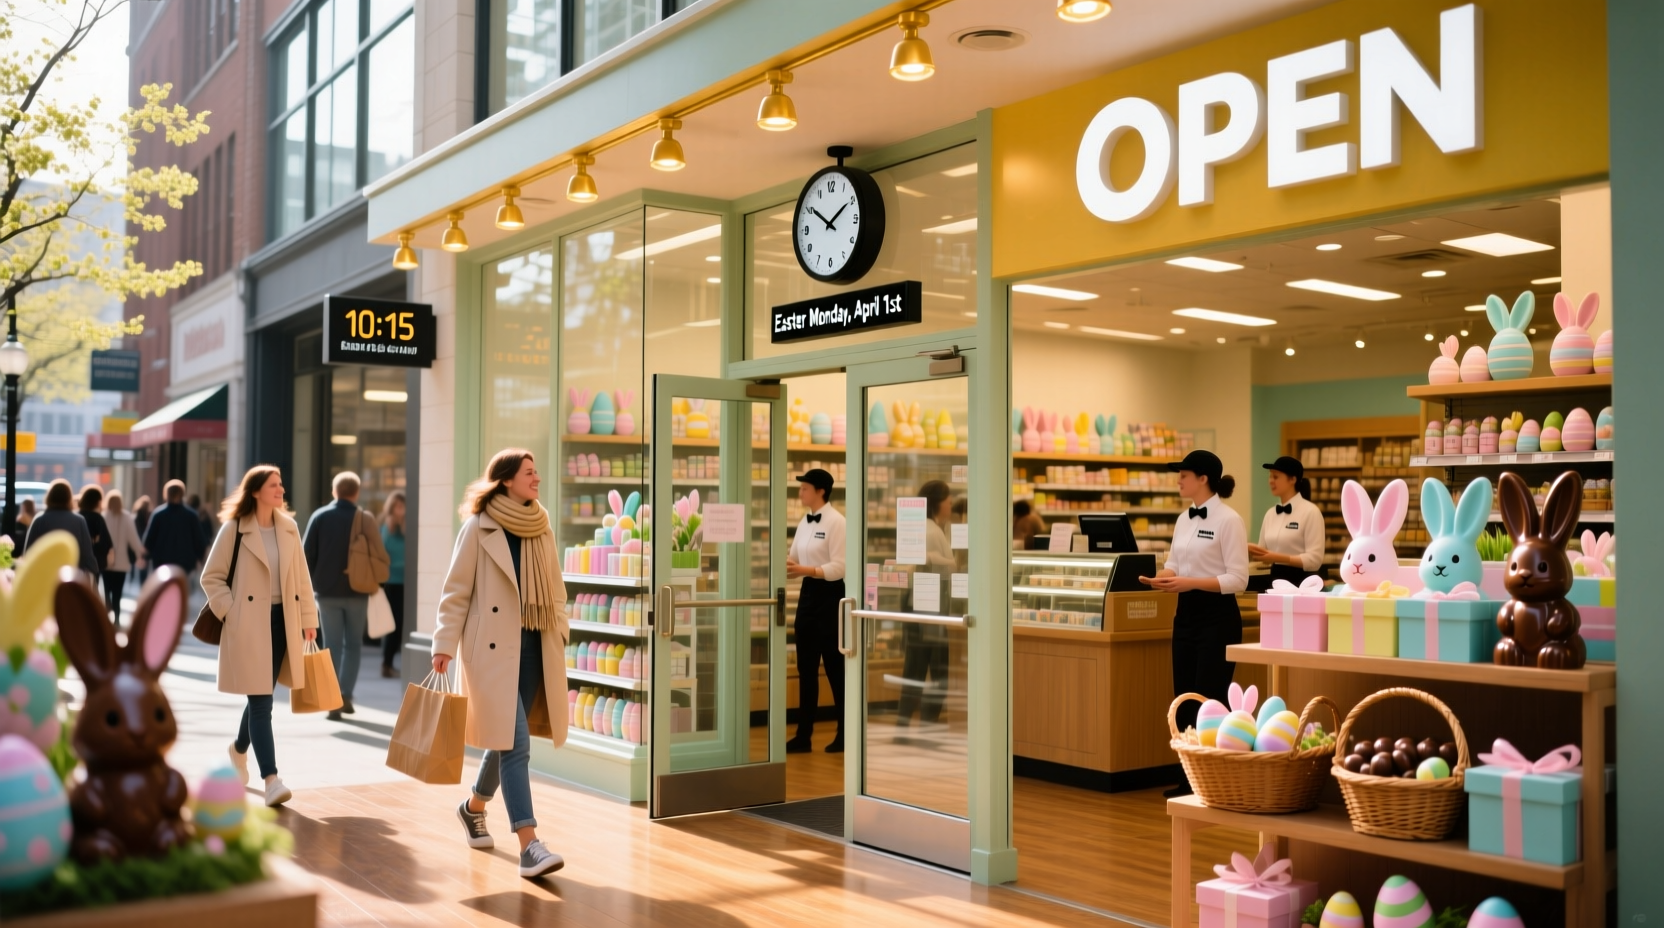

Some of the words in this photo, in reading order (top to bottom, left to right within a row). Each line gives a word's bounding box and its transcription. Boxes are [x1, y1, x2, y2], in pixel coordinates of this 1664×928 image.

[1075, 3, 1482, 222] OPEN
[345, 309, 415, 341] 10:15
[774, 312, 807, 333] Easter
[809, 303, 852, 327] Monday,
[854, 295, 880, 323] April
[883, 294, 902, 314] 1st
